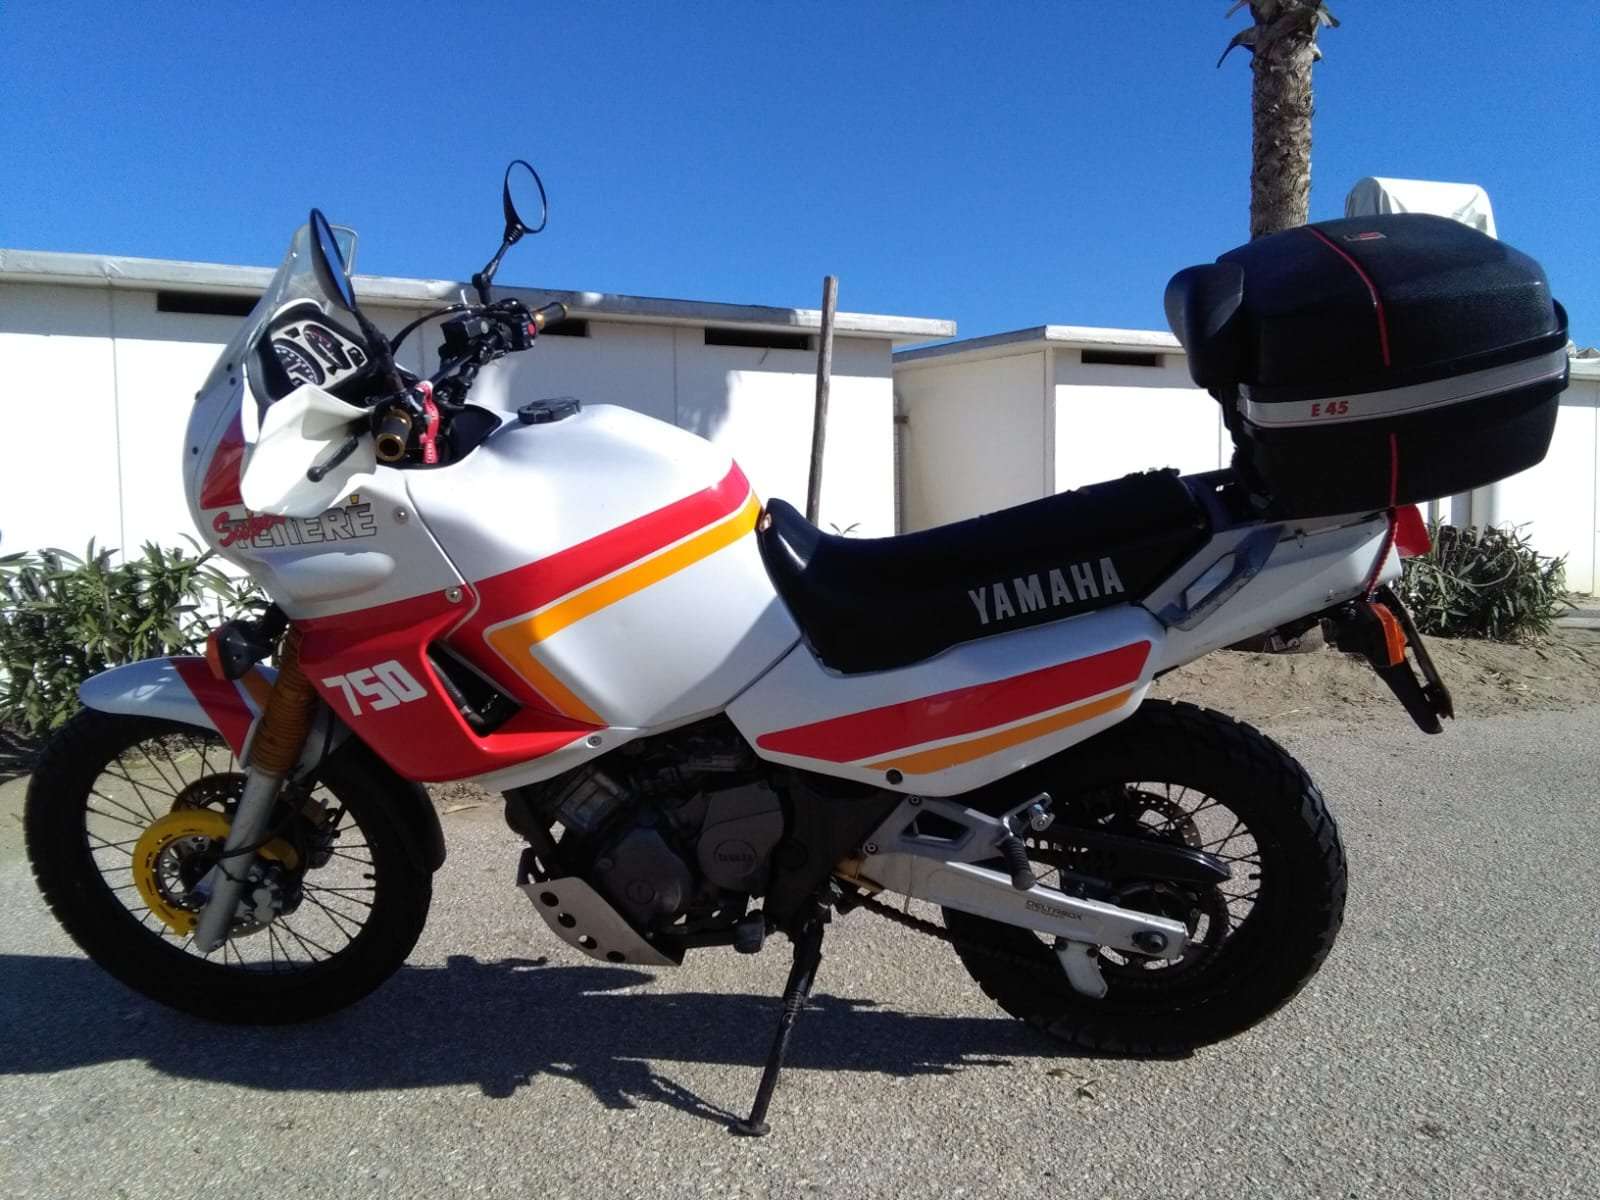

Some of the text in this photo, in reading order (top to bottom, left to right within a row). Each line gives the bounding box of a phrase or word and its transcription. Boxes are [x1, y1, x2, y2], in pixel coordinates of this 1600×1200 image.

[1311, 400, 1349, 417] E 45
[967, 556, 1125, 625] YAMAHA
[321, 659, 428, 716] 750
